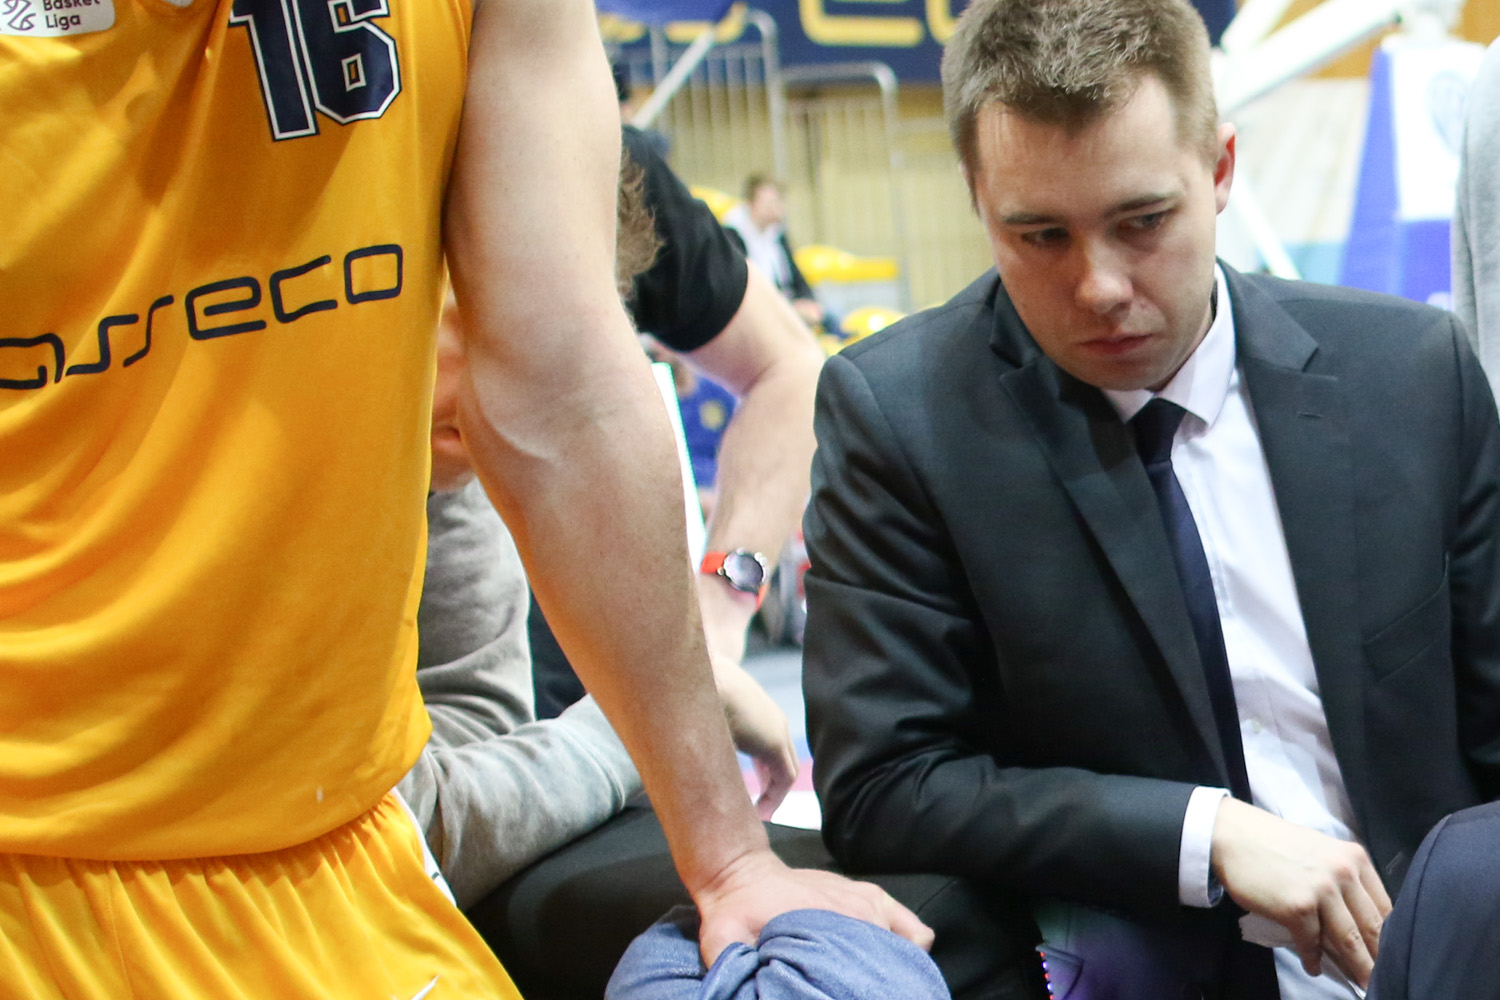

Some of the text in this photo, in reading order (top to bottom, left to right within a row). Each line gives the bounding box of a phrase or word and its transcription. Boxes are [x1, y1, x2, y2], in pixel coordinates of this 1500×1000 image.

[45, 14, 81, 31] Liga
[228, 0, 402, 142] 16
[0, 244, 403, 390] asseco
